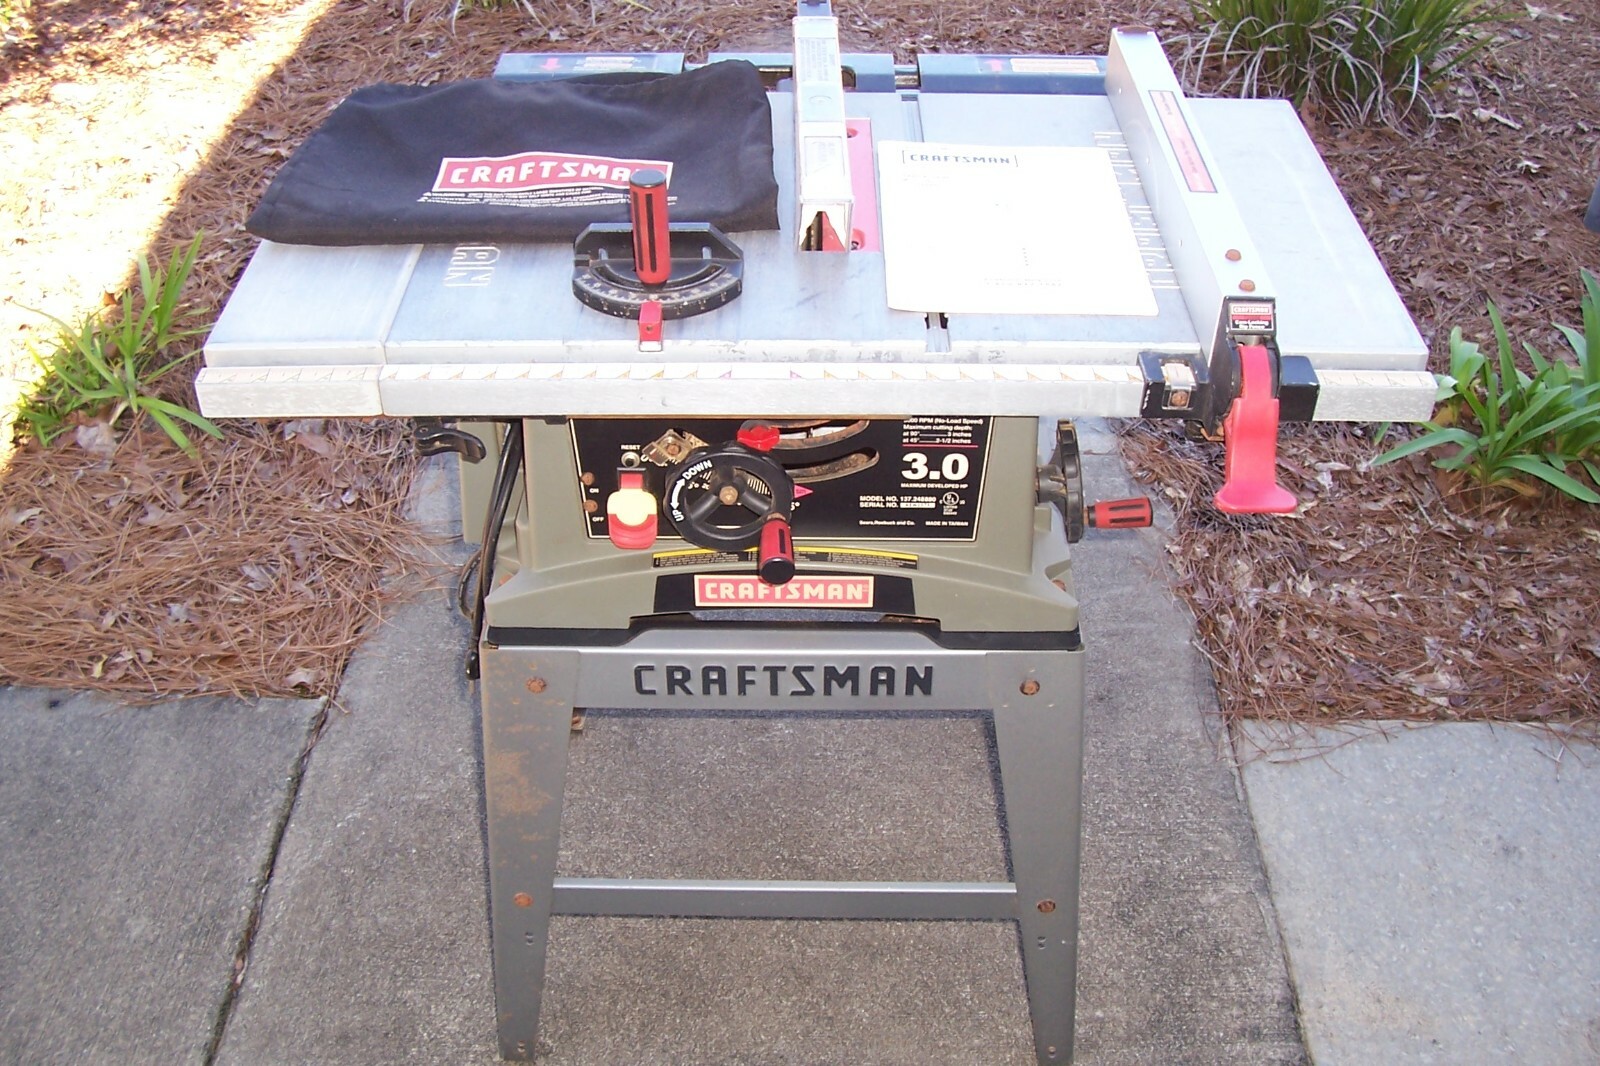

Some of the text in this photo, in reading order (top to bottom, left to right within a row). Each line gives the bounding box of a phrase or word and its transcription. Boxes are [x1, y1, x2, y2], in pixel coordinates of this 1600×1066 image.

[909, 153, 1011, 165] CRAFTSMAN
[450, 161, 633, 184] CRAFTSMA
[682, 459, 713, 481] DOWN
[901, 452, 969, 481] 3.0
[672, 508, 685, 522] UP
[705, 582, 864, 601] CRAFTSMAN
[632, 664, 934, 697] CRAFTSMAN
